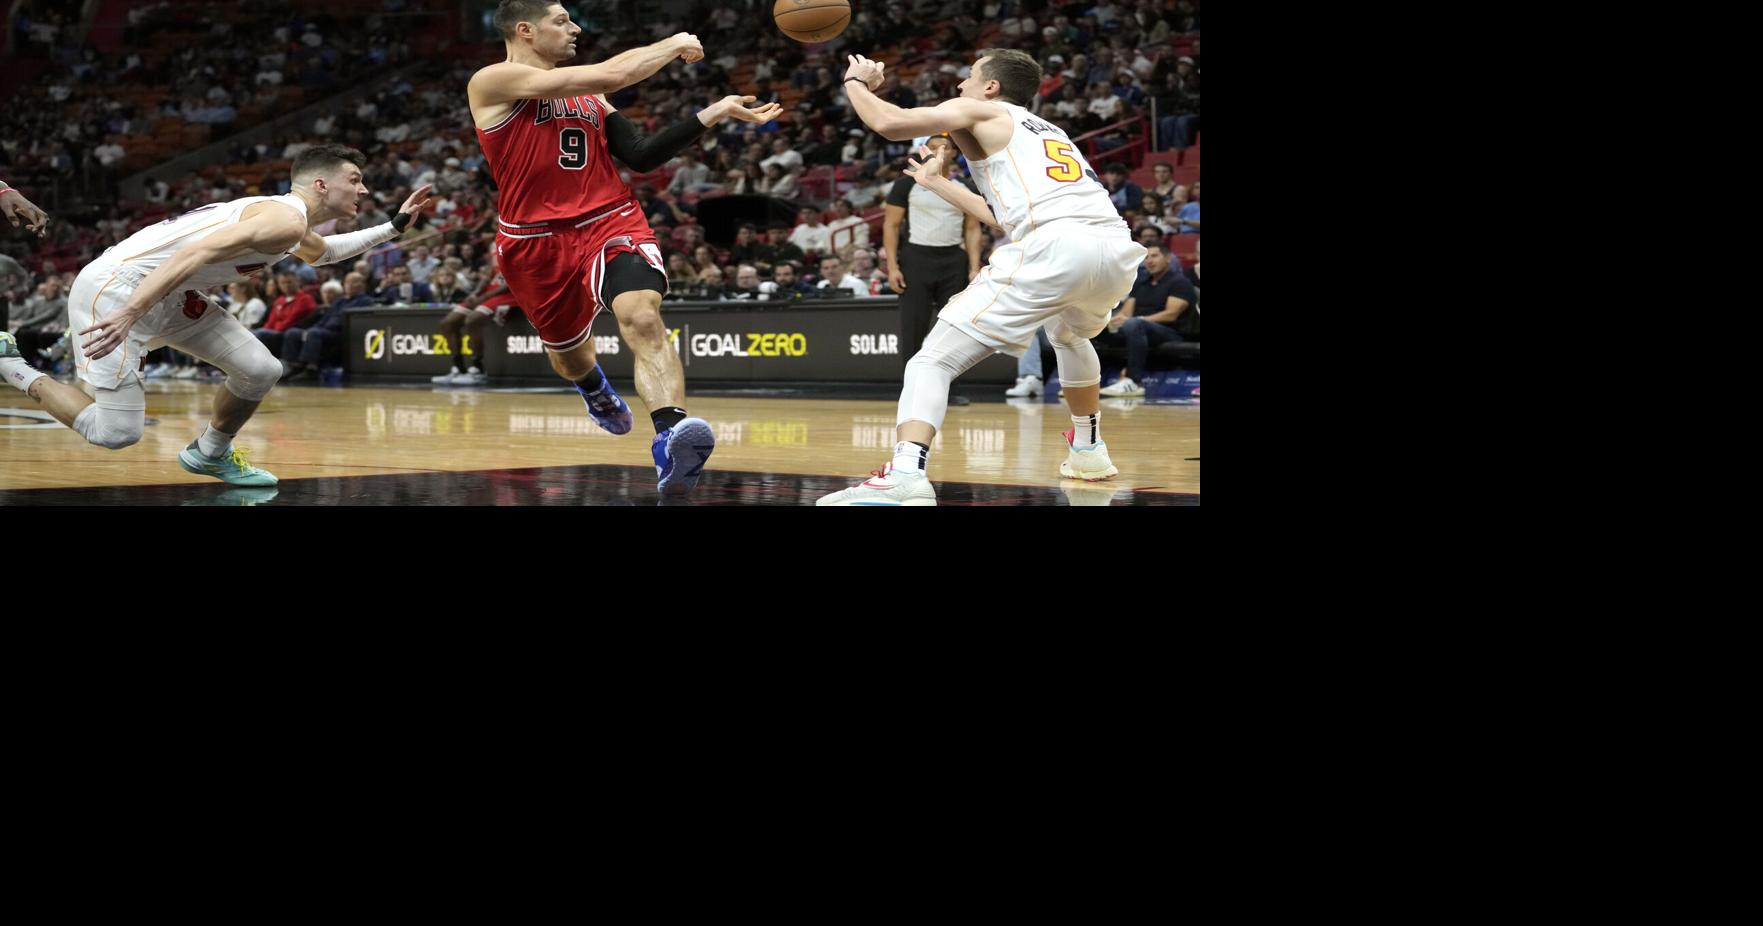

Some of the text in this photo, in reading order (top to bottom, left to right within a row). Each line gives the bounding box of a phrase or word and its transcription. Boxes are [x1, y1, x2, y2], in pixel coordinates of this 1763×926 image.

[558, 127, 588, 170] 9
[1042, 139, 1099, 182] 5
[691, 333, 807, 356] GOALZERO
[850, 334, 898, 354] SOLAR
